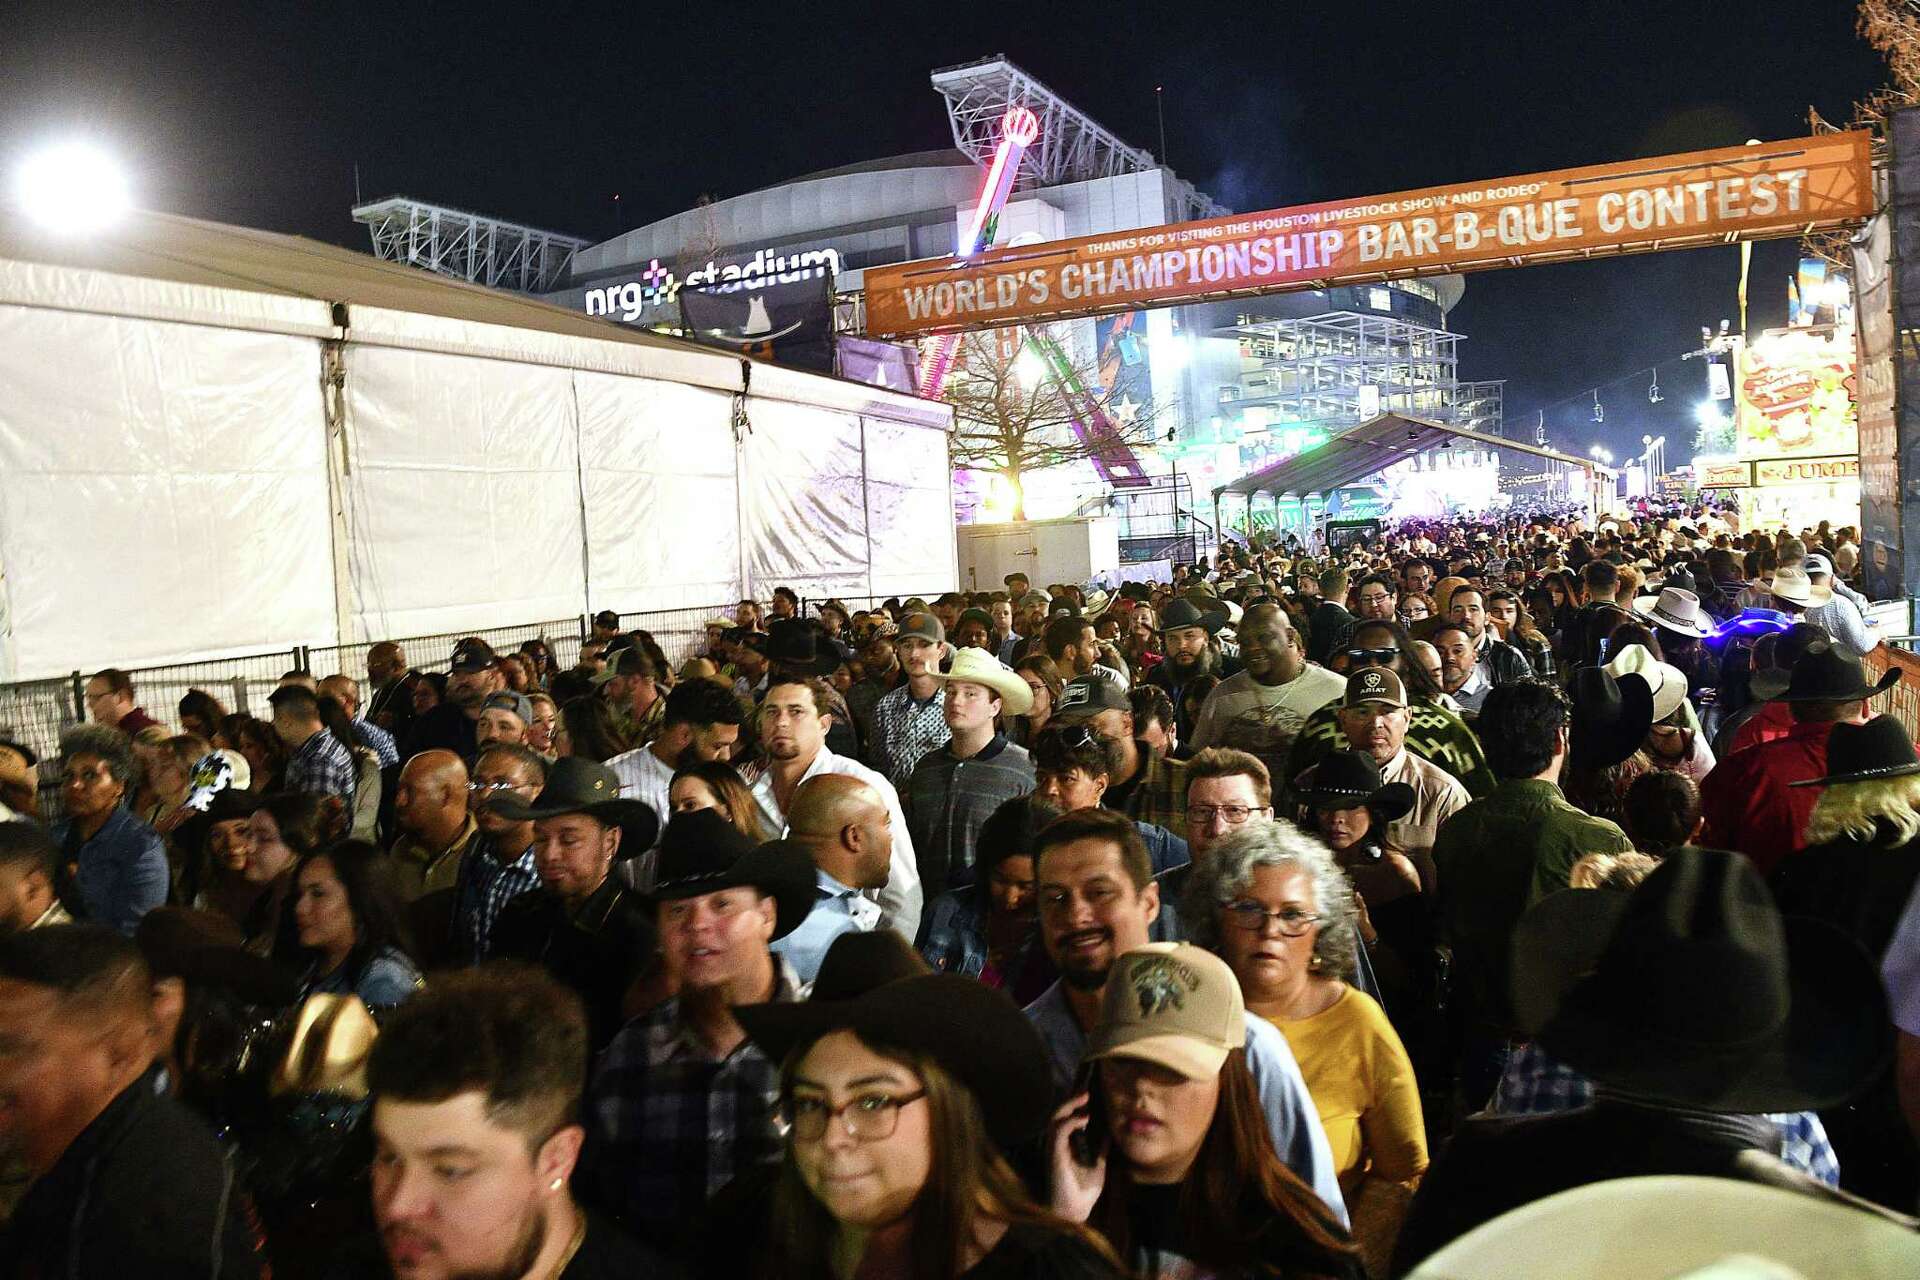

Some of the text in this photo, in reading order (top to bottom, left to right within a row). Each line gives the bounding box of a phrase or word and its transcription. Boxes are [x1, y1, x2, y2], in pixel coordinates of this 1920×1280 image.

[903, 169, 1807, 321] WORLD'S CHAMPIONSHIP BAR-B-QUE CONTEST
[1088, 238, 1137, 254] THANKS
[1139, 234, 1165, 246] FOR
[1167, 226, 1223, 242] VISITING
[1226, 222, 1250, 234] THE
[1252, 212, 1320, 231] HOUSTON
[1323, 202, 1398, 221] LIVESTOCK
[1402, 195, 1447, 212] SHOW
[1451, 190, 1483, 205] AND
[584, 248, 840, 322] nrg stadium
[1359, 687, 1387, 695] ARIAT
